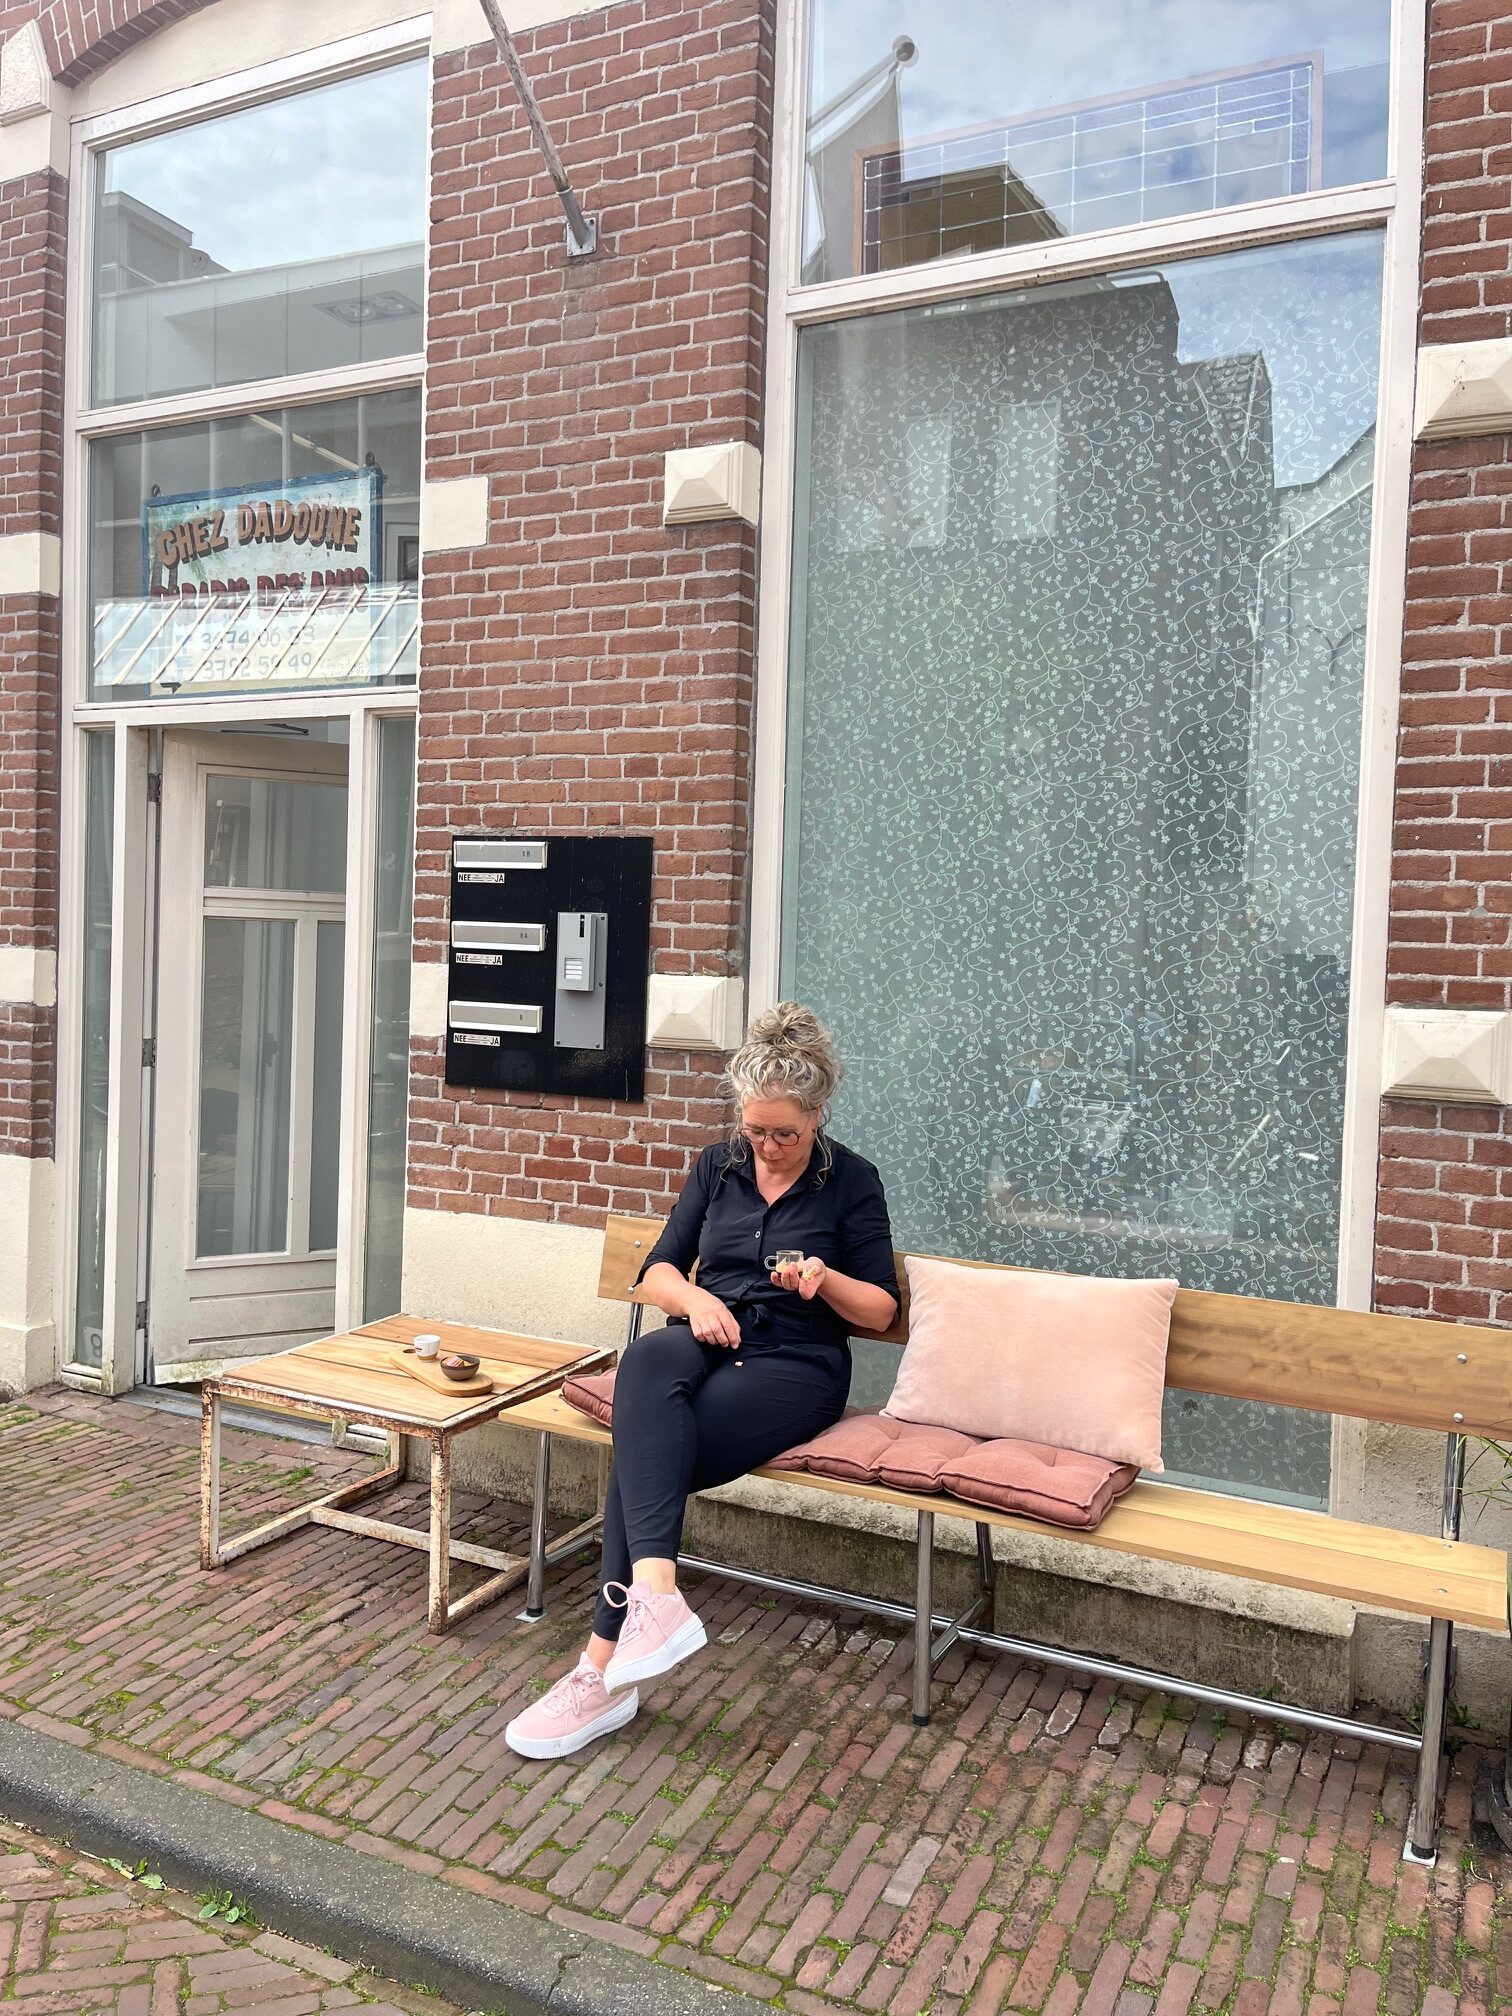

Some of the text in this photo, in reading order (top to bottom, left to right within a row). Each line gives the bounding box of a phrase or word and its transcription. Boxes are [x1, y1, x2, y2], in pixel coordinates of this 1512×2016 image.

[160, 499, 362, 569] CHEZ DADOUNE
[492, 956, 502, 964] JA
[490, 1037, 499, 1045] JA
